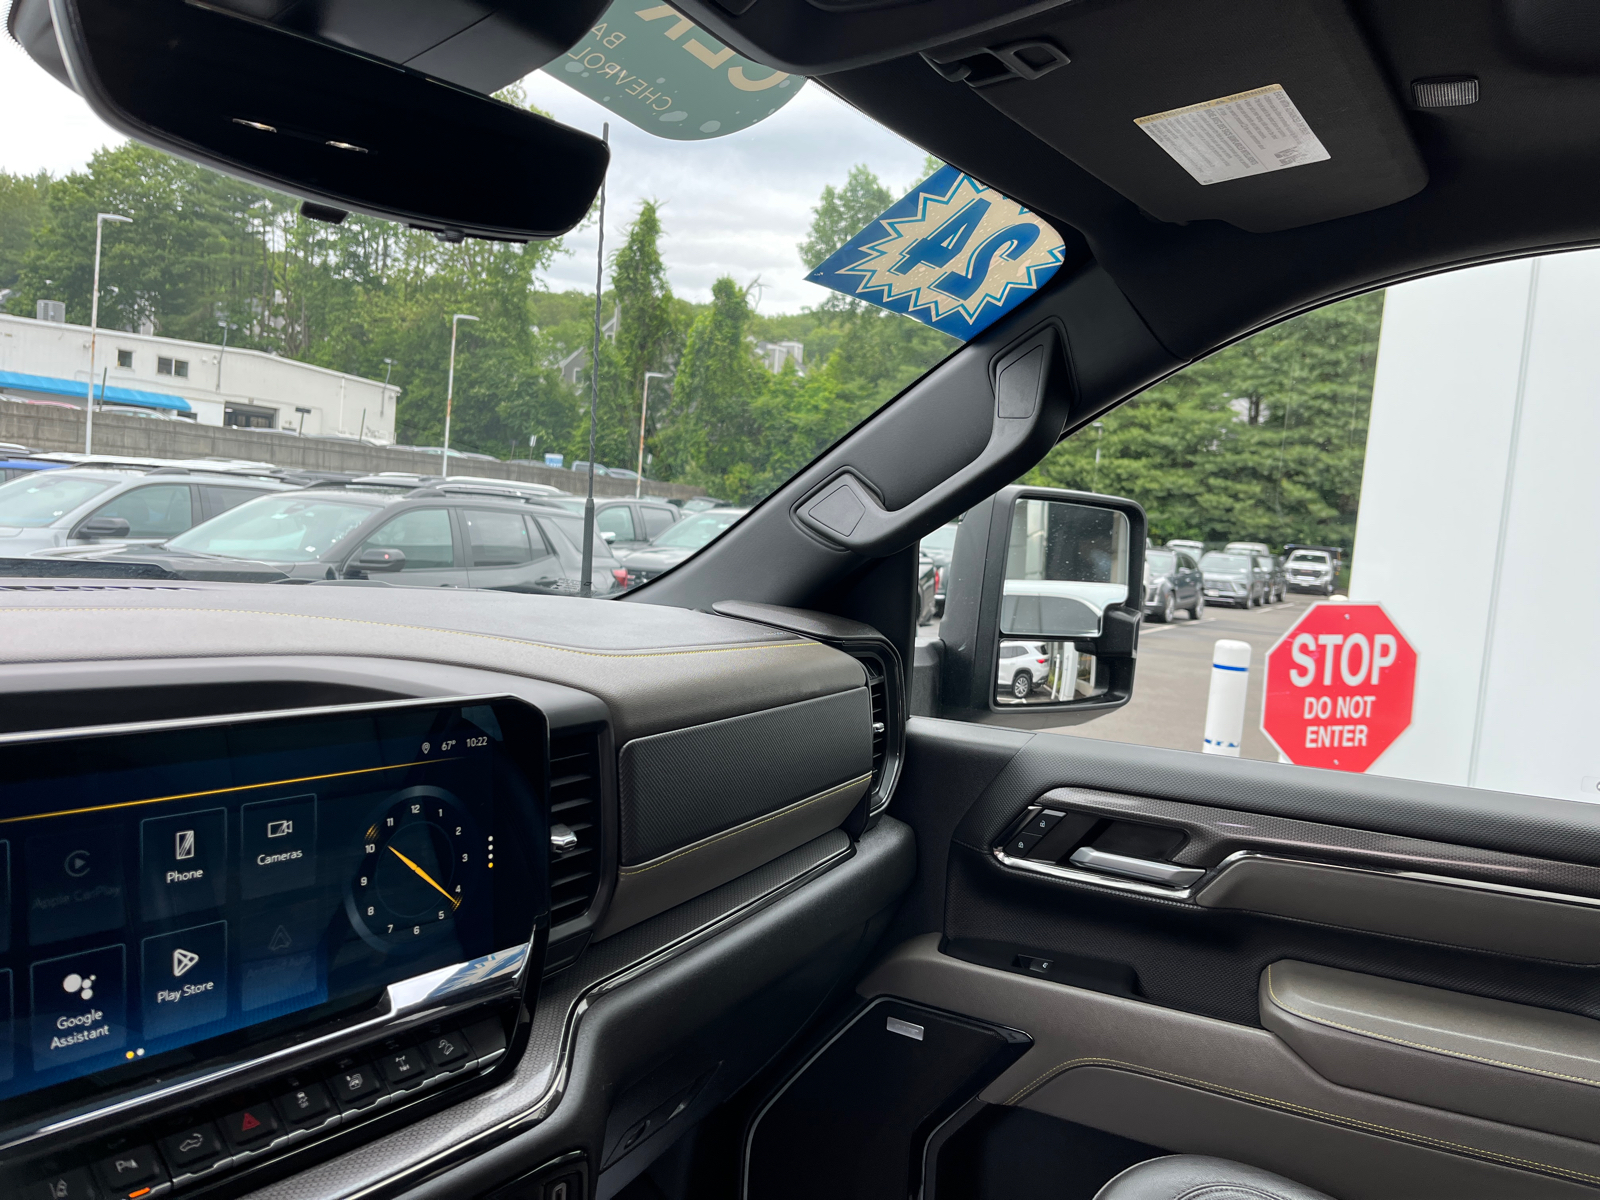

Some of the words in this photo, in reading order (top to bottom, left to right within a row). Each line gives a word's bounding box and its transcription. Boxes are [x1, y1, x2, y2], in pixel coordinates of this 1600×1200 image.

[1289, 632, 1398, 687] STOP
[1303, 695, 1332, 720] DO
[1336, 695, 1377, 719] NOT
[1304, 724, 1369, 748] ENTER
[466, 736, 488, 748] 10:22
[411, 804, 421, 814] 12
[386, 817, 394, 827] 11
[455, 826, 462, 836] 2
[365, 843, 376, 854] 10
[256, 849, 303, 867] Cameras
[462, 853, 468, 863] 3
[166, 868, 204, 884] Phone
[360, 876, 368, 886] 9
[455, 884, 461, 893] 4
[367, 906, 375, 916] 8
[438, 910, 445, 920] 5
[387, 924, 394, 934] 7
[413, 925, 420, 935] 6
[157, 988, 182, 1004] Play
[183, 981, 214, 997] Store
[56, 1008, 104, 1030] Google
[50, 1024, 110, 1050] Assistant
